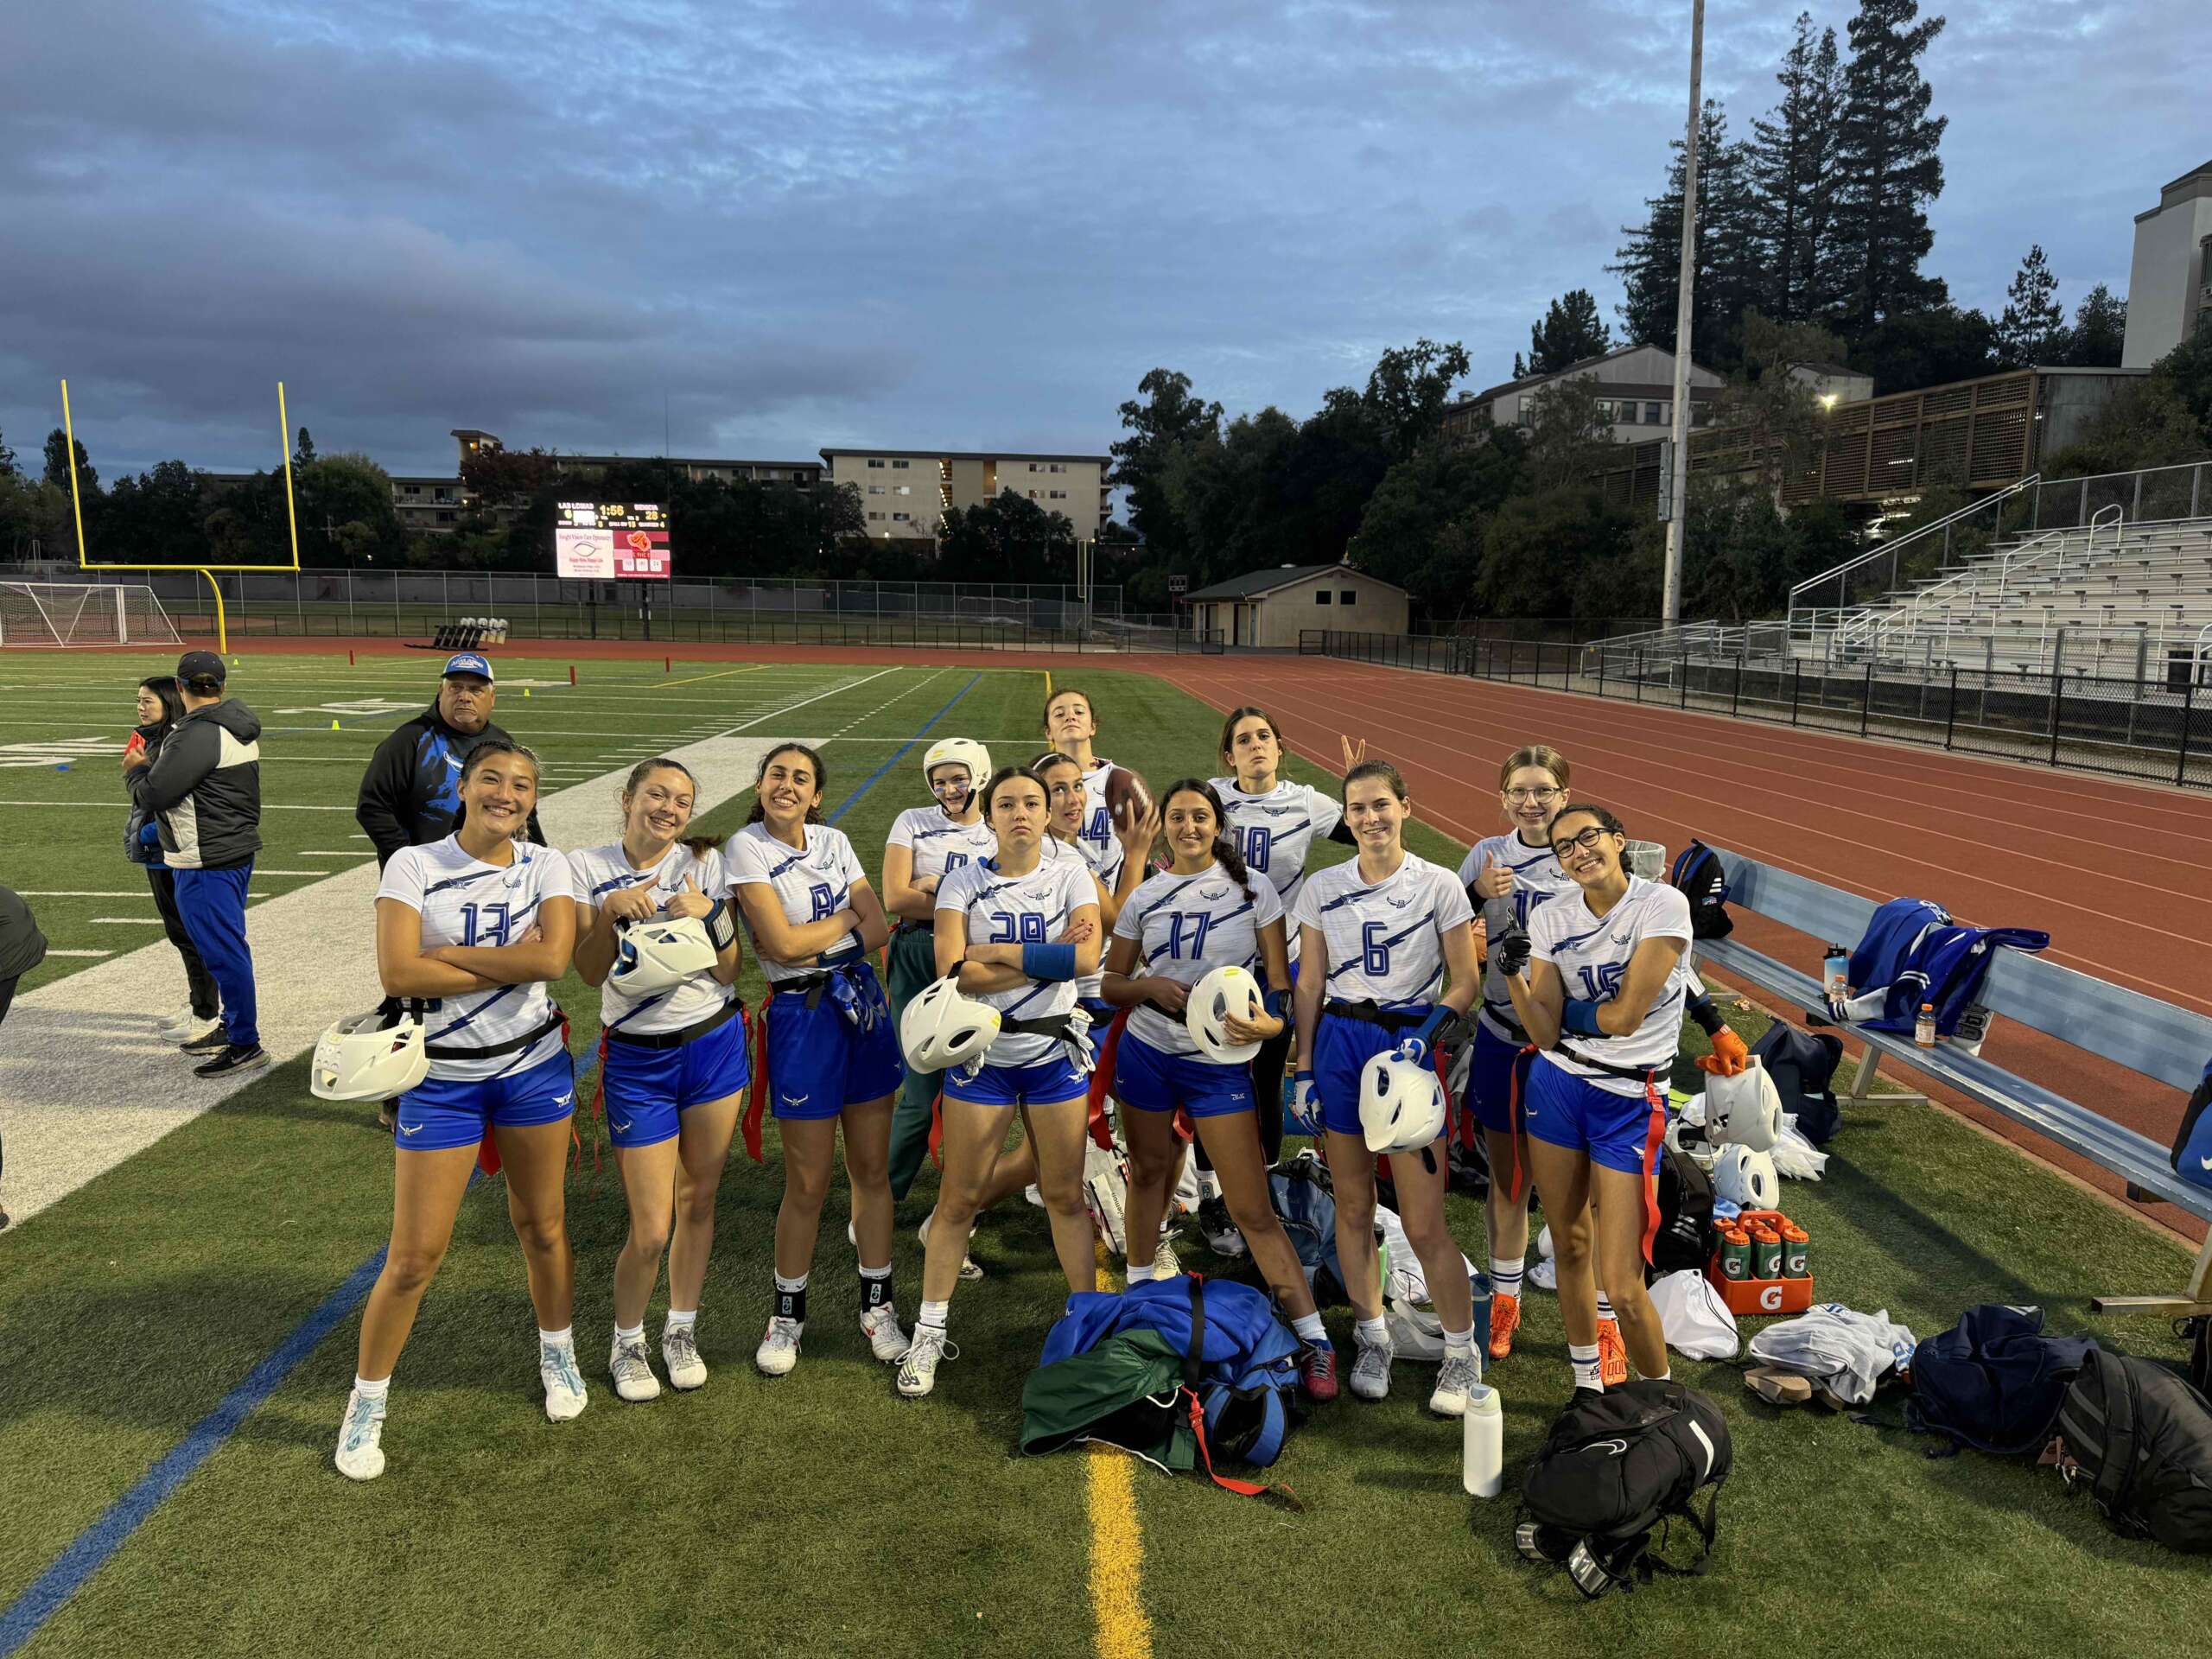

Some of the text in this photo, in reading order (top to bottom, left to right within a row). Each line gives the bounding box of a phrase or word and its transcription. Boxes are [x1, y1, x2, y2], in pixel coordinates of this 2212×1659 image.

[1231, 826, 1271, 874] 10
[460, 902, 511, 947] 13
[989, 912, 1046, 944] 29
[1169, 911, 1211, 960] 17
[1362, 921, 1389, 976] 6
[1725, 1258, 1741, 1274] G
[1789, 1255, 1806, 1272] G
[1760, 1286, 1783, 1310] G
